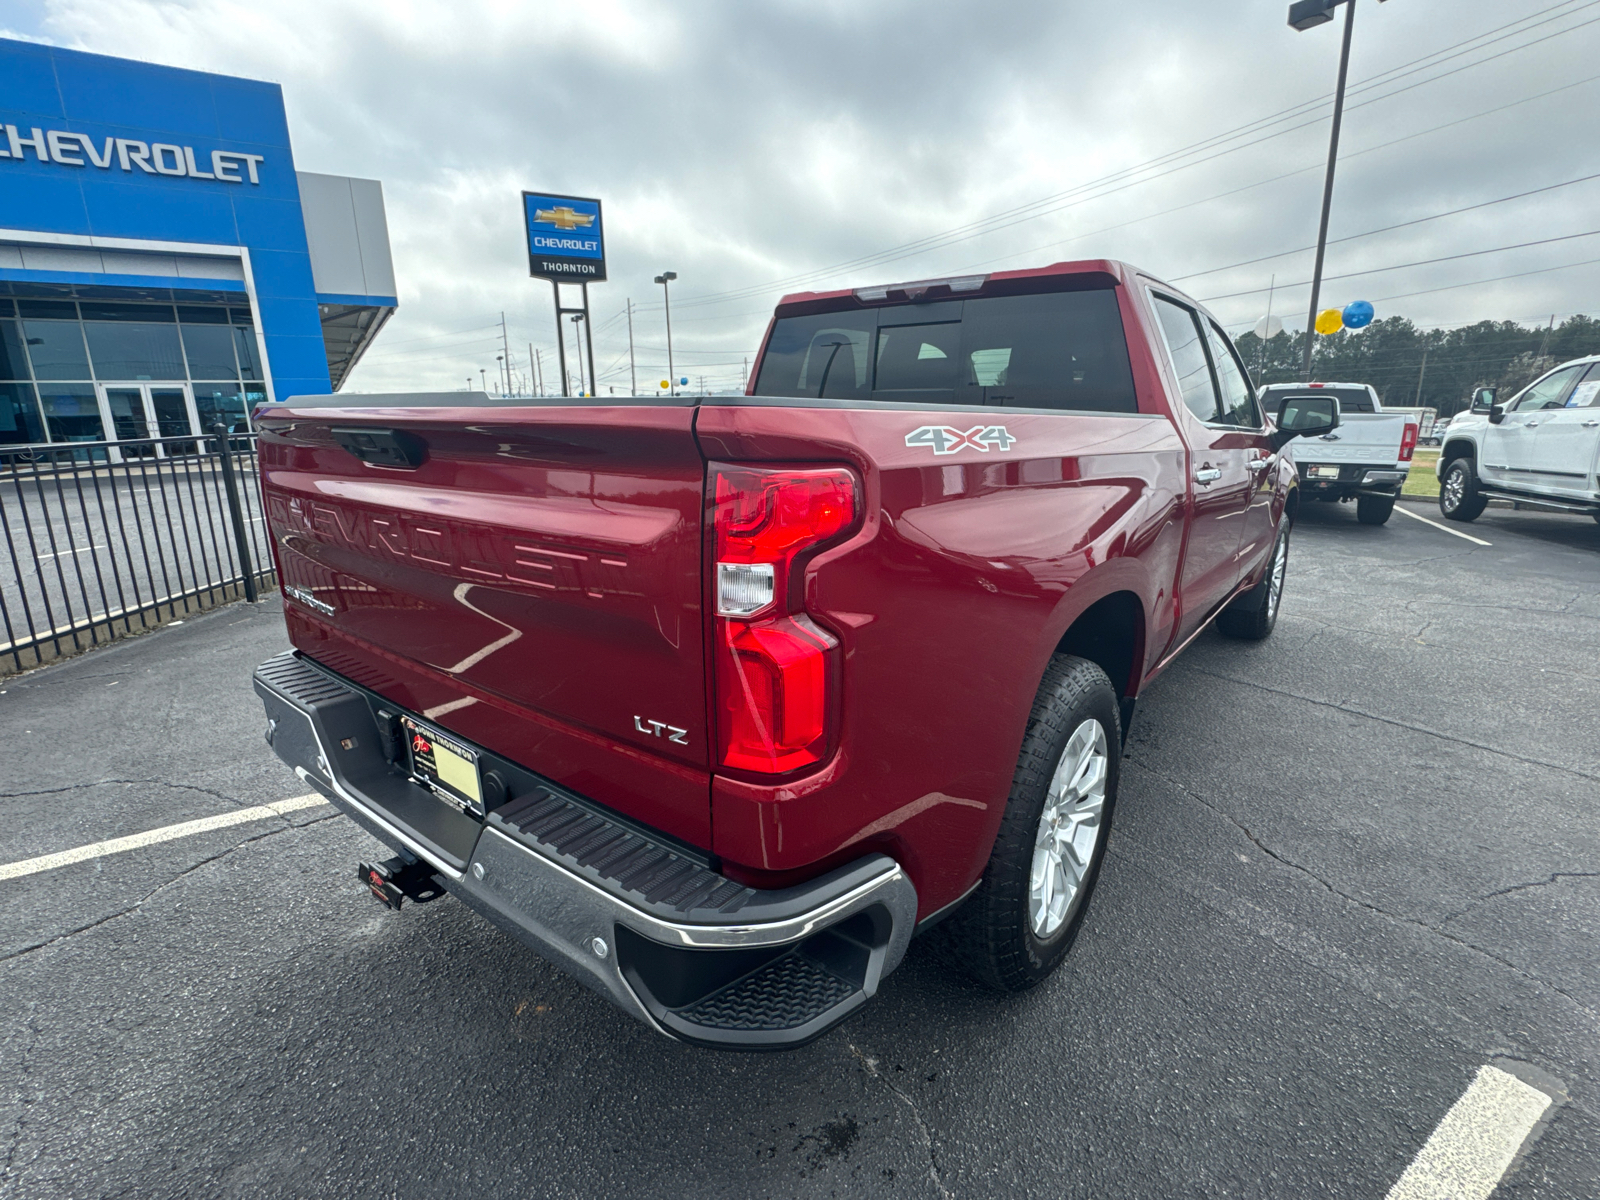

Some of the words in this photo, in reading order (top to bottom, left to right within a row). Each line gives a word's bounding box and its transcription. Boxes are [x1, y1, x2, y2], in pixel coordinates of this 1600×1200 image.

[534, 236, 598, 251] CHEVROLET
[542, 261, 596, 274] THORNTON
[633, 715, 689, 745] LTZ
